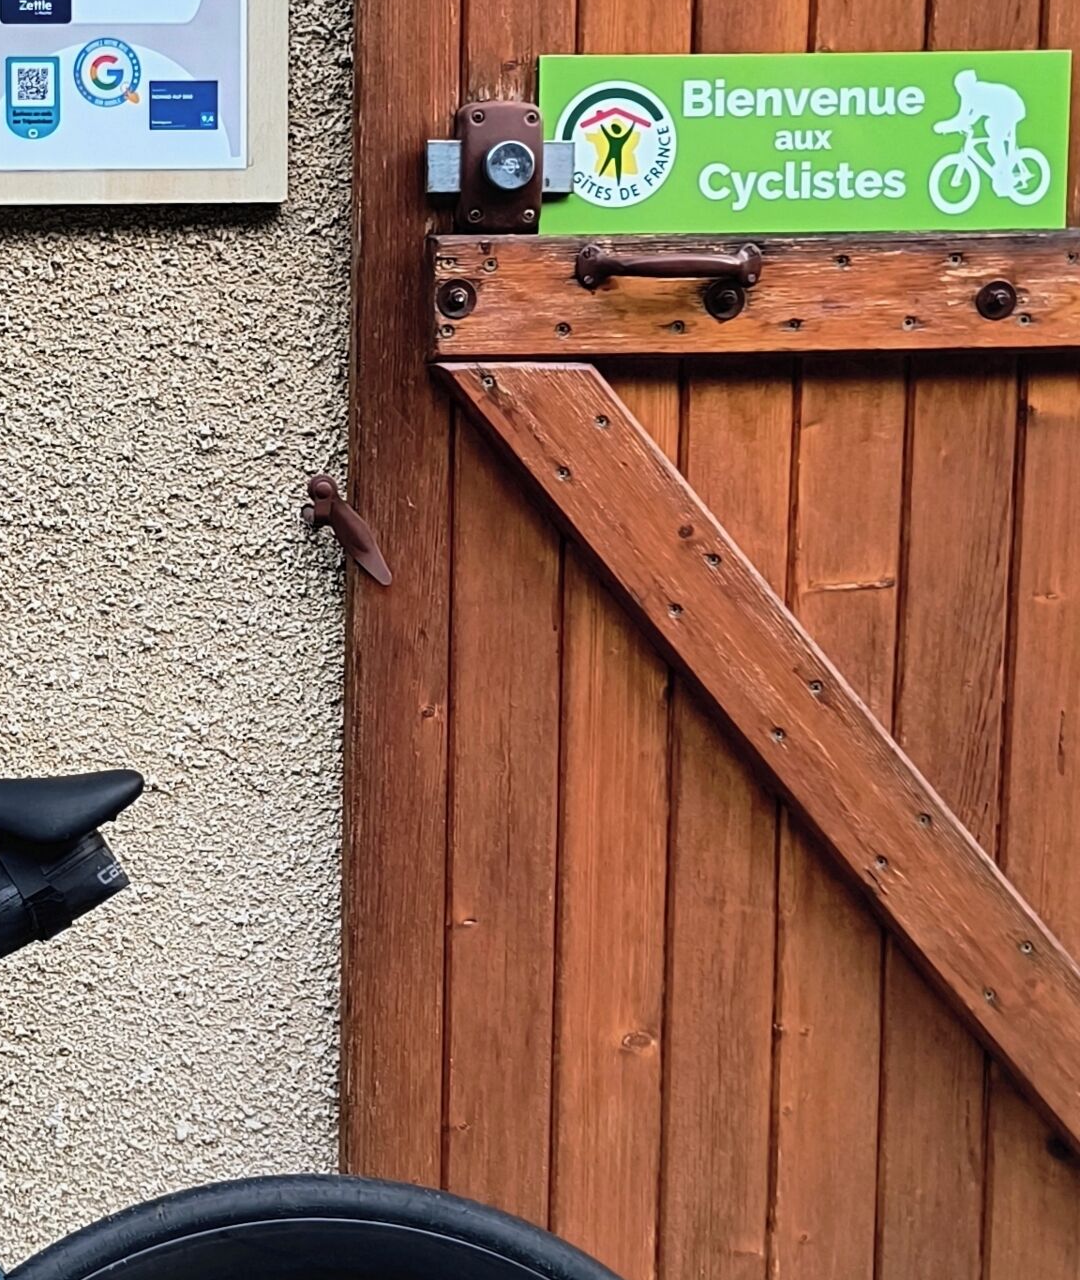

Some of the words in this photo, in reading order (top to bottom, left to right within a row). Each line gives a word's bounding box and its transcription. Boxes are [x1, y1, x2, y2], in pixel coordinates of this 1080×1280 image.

[19, 0, 53, 11] Zettle
[682, 79, 926, 118] Bienvenue
[774, 127, 832, 151] aux
[573, 169, 614, 202] GÎTES
[619, 184, 642, 201] DE
[643, 124, 673, 190] FRANCE
[698, 162, 907, 211] Cyclistes
